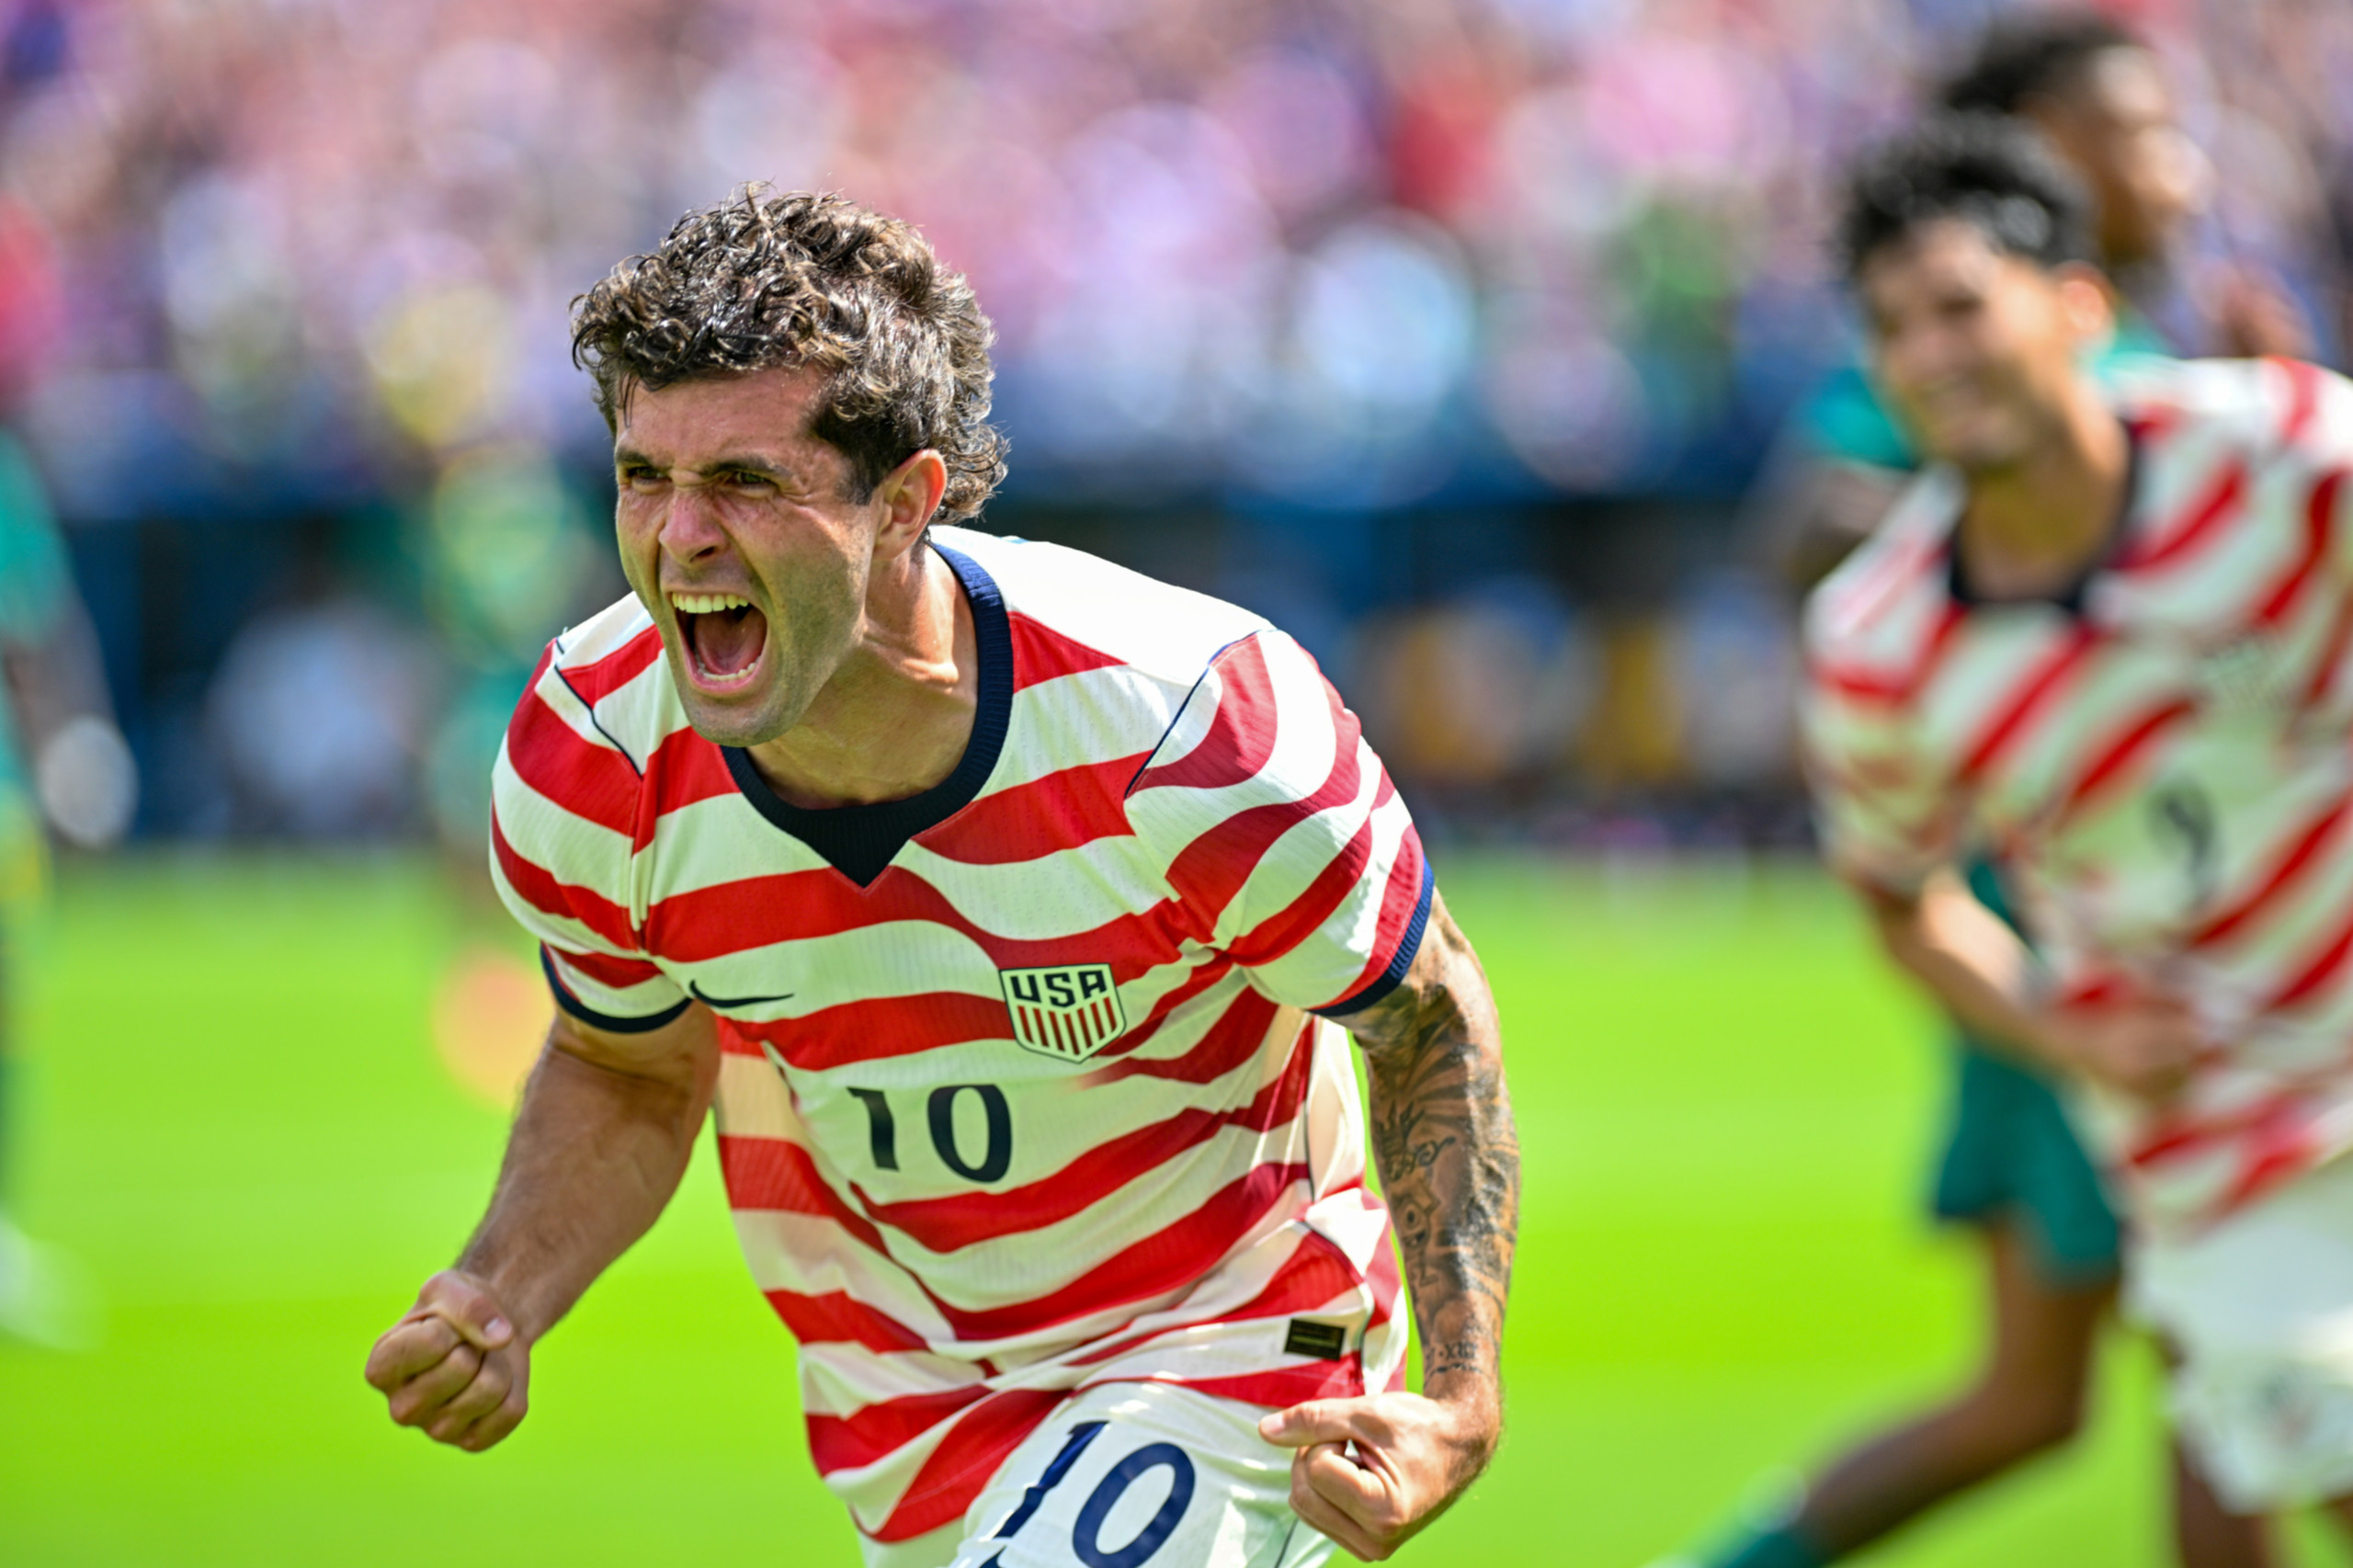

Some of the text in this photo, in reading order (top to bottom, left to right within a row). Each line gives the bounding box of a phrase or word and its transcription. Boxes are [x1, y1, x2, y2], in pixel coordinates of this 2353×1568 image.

[1009, 969, 1108, 1008] USA
[846, 1084, 1012, 1184] 10
[993, 1419, 1197, 1568] 10
